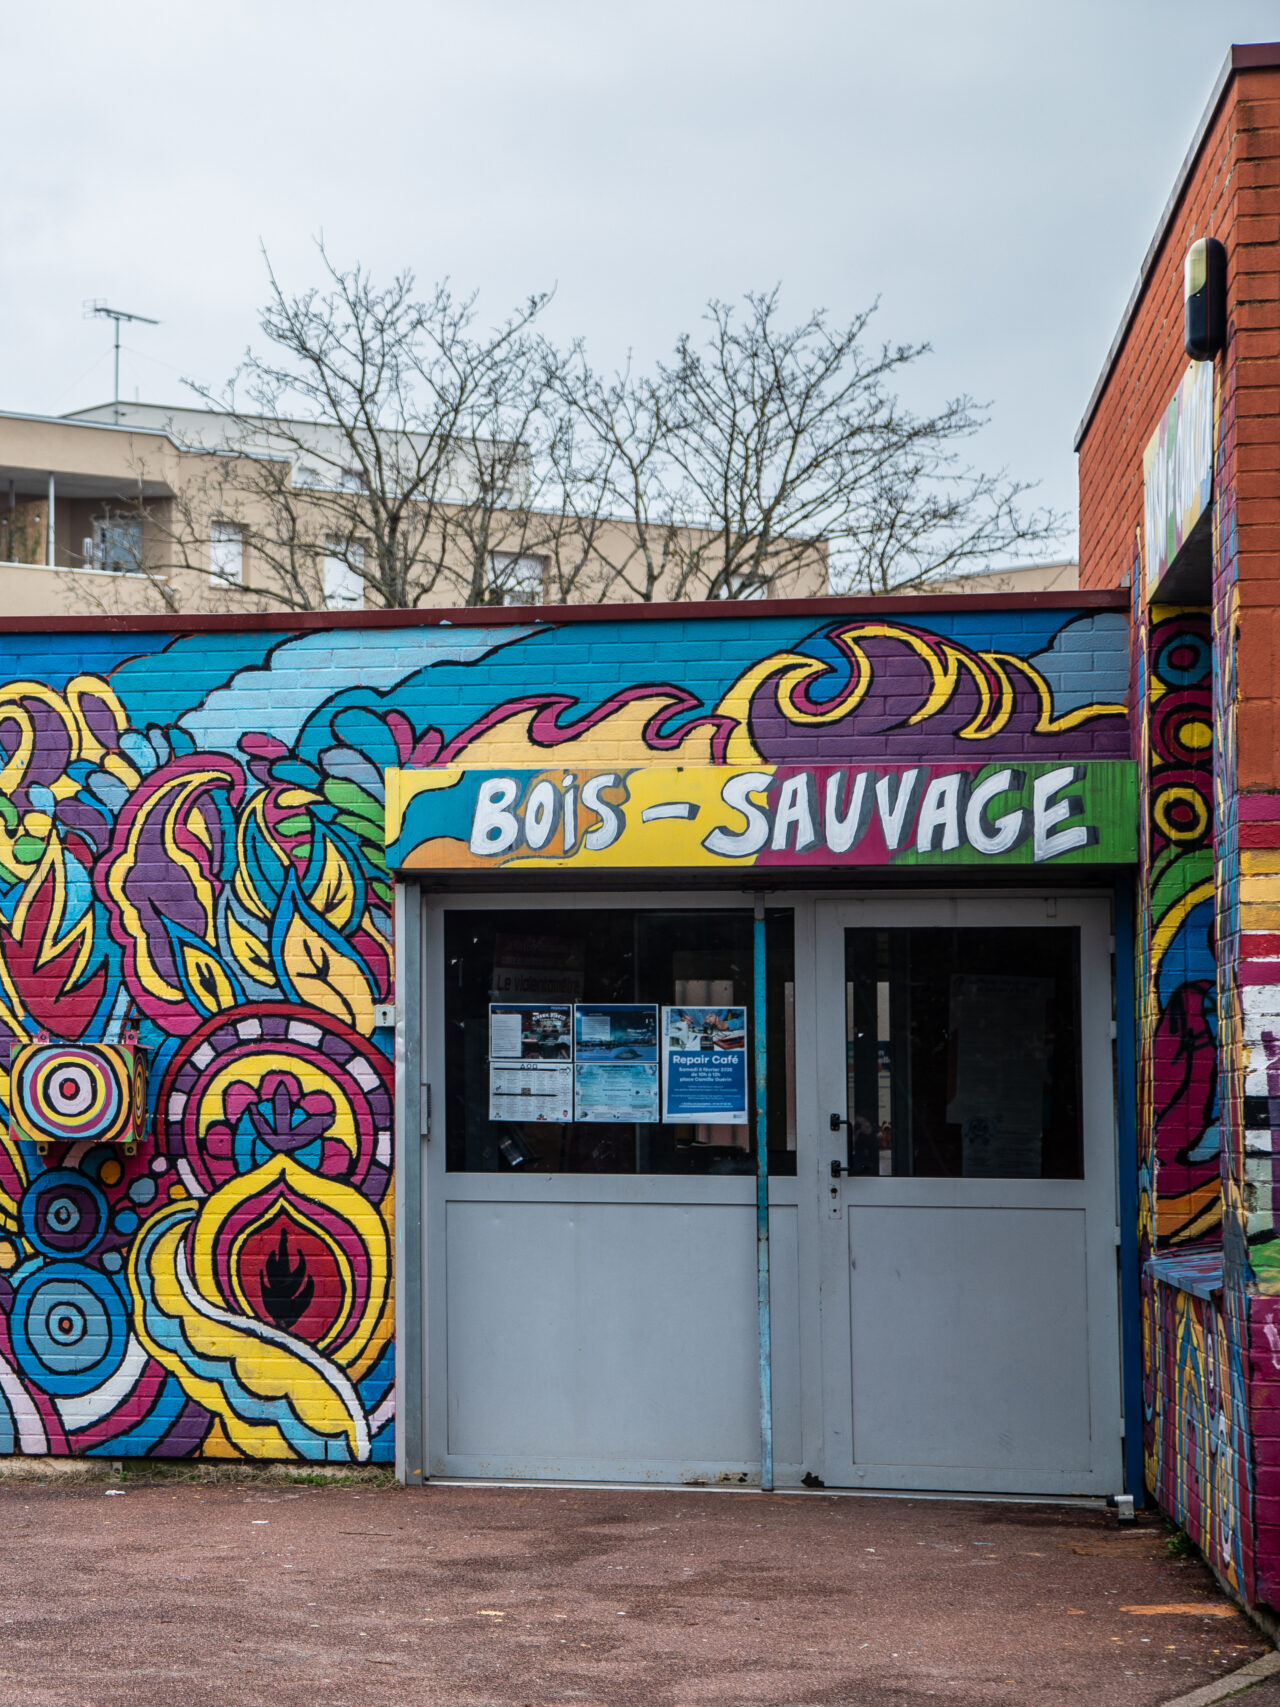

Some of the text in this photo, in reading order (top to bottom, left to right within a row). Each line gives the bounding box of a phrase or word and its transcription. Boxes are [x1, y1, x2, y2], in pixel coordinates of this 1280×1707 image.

[702, 765, 1092, 862] SAUVAGE
[672, 1055, 739, 1065] Repair Café
